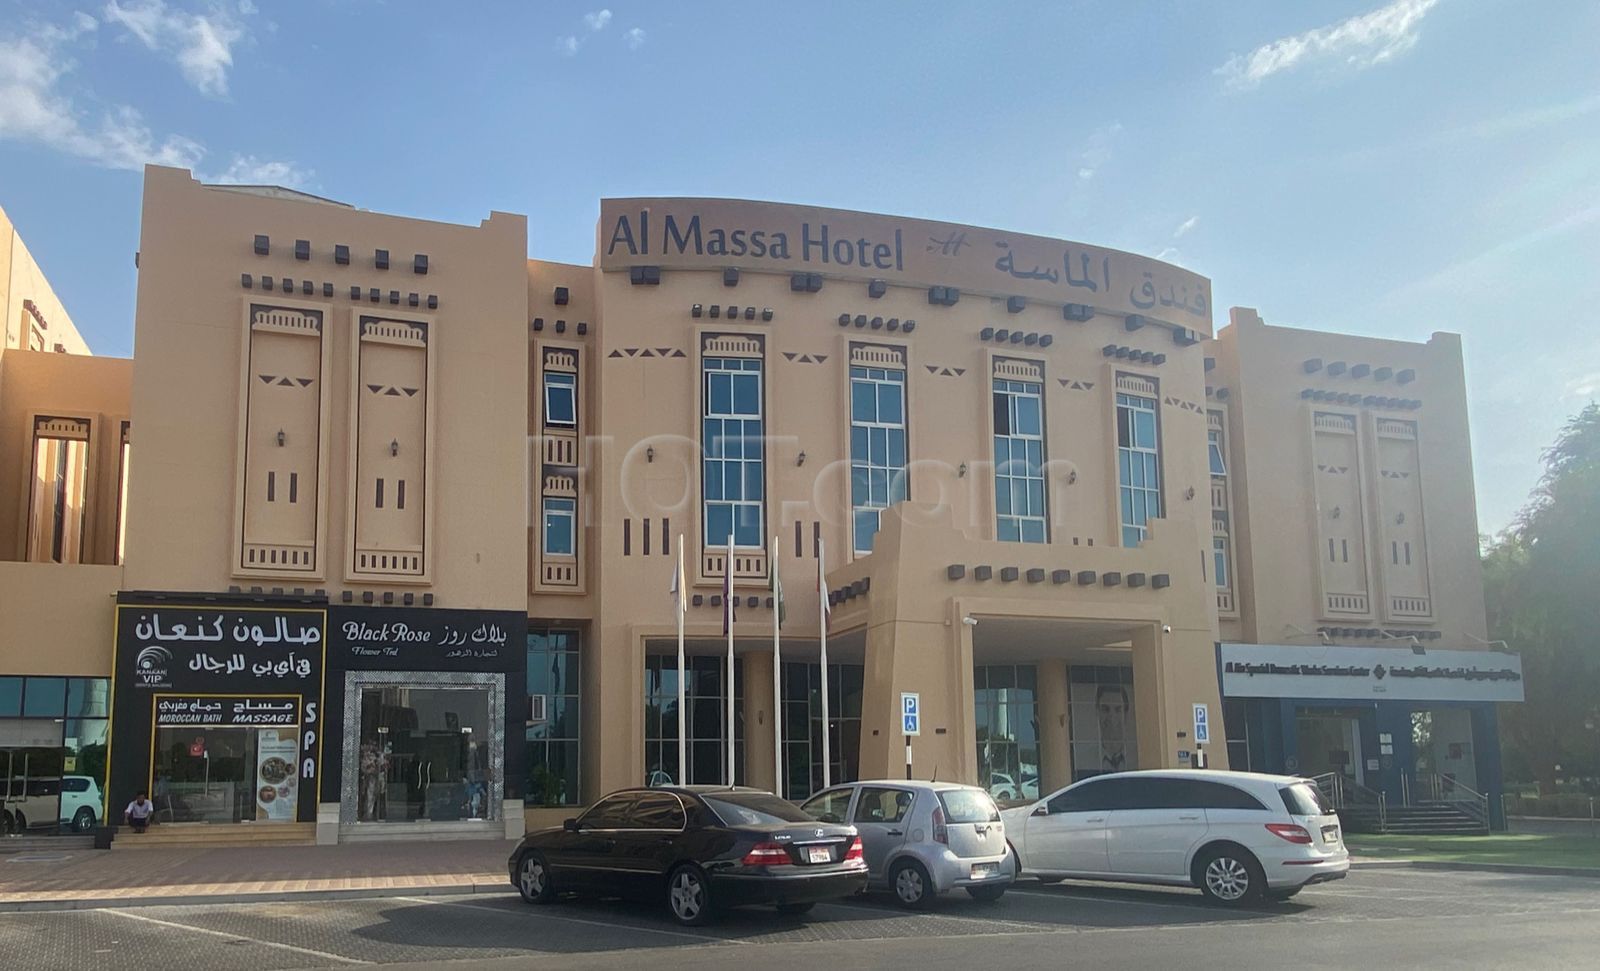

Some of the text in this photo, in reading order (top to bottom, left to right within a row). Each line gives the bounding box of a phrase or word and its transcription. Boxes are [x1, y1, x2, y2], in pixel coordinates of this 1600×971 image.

[607, 210, 904, 272] Al Massa Hotel
[995, 240, 1206, 317] فندق الماسة
[135, 613, 321, 647] صالون كنعان
[342, 621, 431, 642] Black Rose
[437, 623, 507, 647] بلاك روز
[351, 646, 381, 656] Flower
[188, 653, 246, 674] للرجال
[143, 674, 162, 683] VIP
[158, 698, 222, 713] حمام مغربي
[233, 698, 293, 713] مساج
[906, 698, 915, 713] P
[158, 713, 223, 723] MOROCCAN BATH
[232, 713, 294, 723] MASSAGE
[1197, 708, 1205, 722] P
[302, 702, 317, 779] SPA
